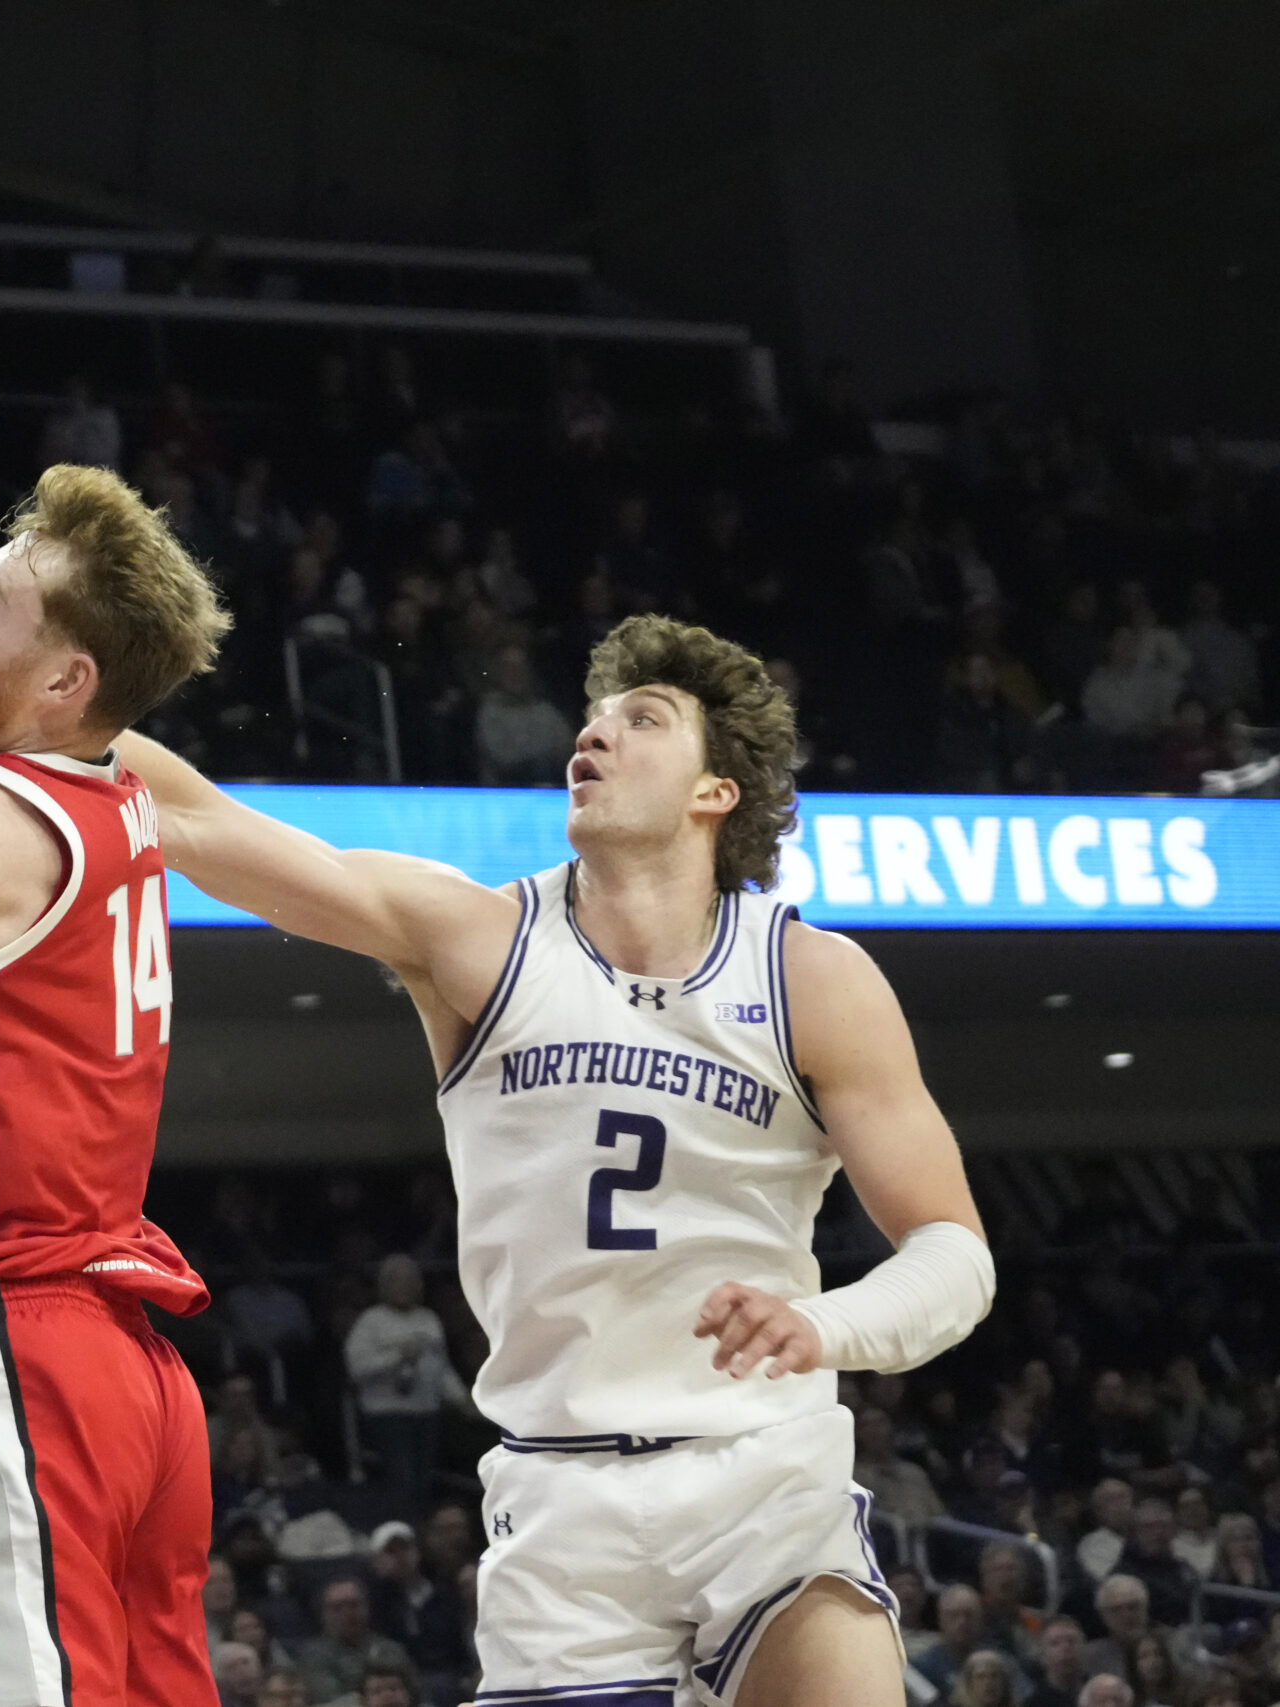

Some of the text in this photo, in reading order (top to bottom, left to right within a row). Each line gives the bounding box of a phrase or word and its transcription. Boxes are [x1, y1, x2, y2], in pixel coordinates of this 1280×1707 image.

[775, 813, 1220, 909] SERVICES
[106, 874, 173, 1057] 14
[500, 1041, 781, 1130] NORTHWESTERN
[586, 1108, 667, 1251] 2
